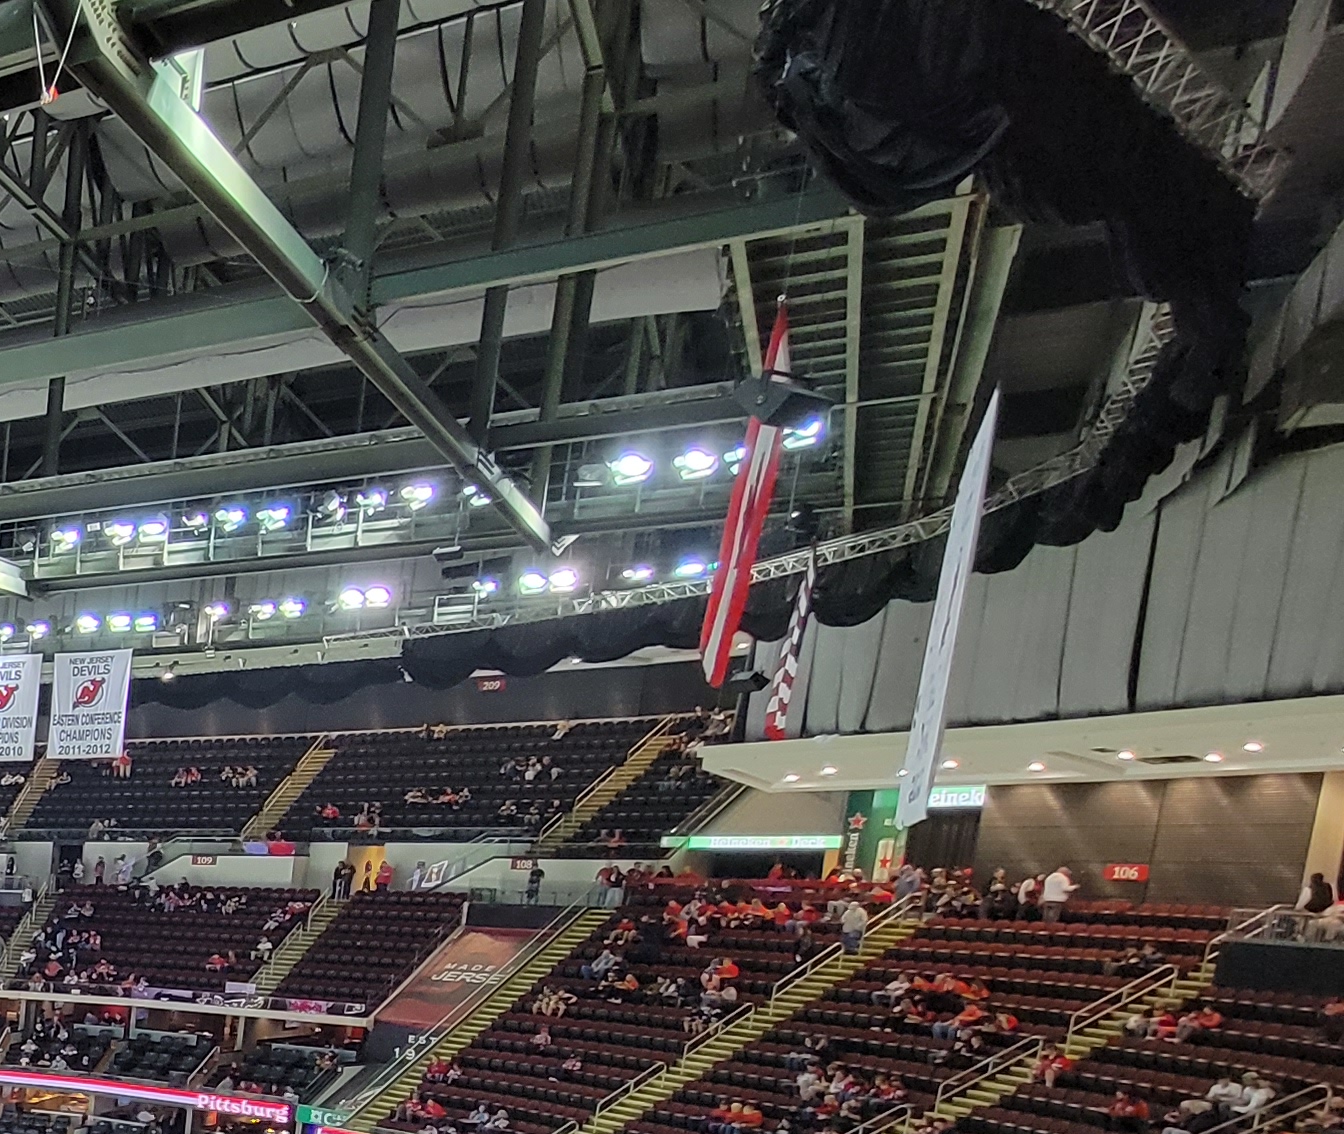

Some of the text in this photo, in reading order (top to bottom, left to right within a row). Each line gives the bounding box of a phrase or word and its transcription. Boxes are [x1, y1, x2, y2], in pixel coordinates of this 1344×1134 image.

[0, 661, 26, 669] JERSEY
[87, 656, 115, 664] JERSEY
[73, 665, 111, 676] DEVILS
[2, 717, 32, 728] DIVISION
[53, 712, 122, 726] EASTERN CONFERENCE
[60, 728, 112, 741] CHAMPIONS
[58, 744, 110, 755] 2011-2012
[197, 856, 212, 865] 109
[516, 860, 533, 869] 108
[1112, 866, 1139, 879] 106
[444, 963, 496, 971] MADE
[197, 1095, 288, 1124] Pittsburg
